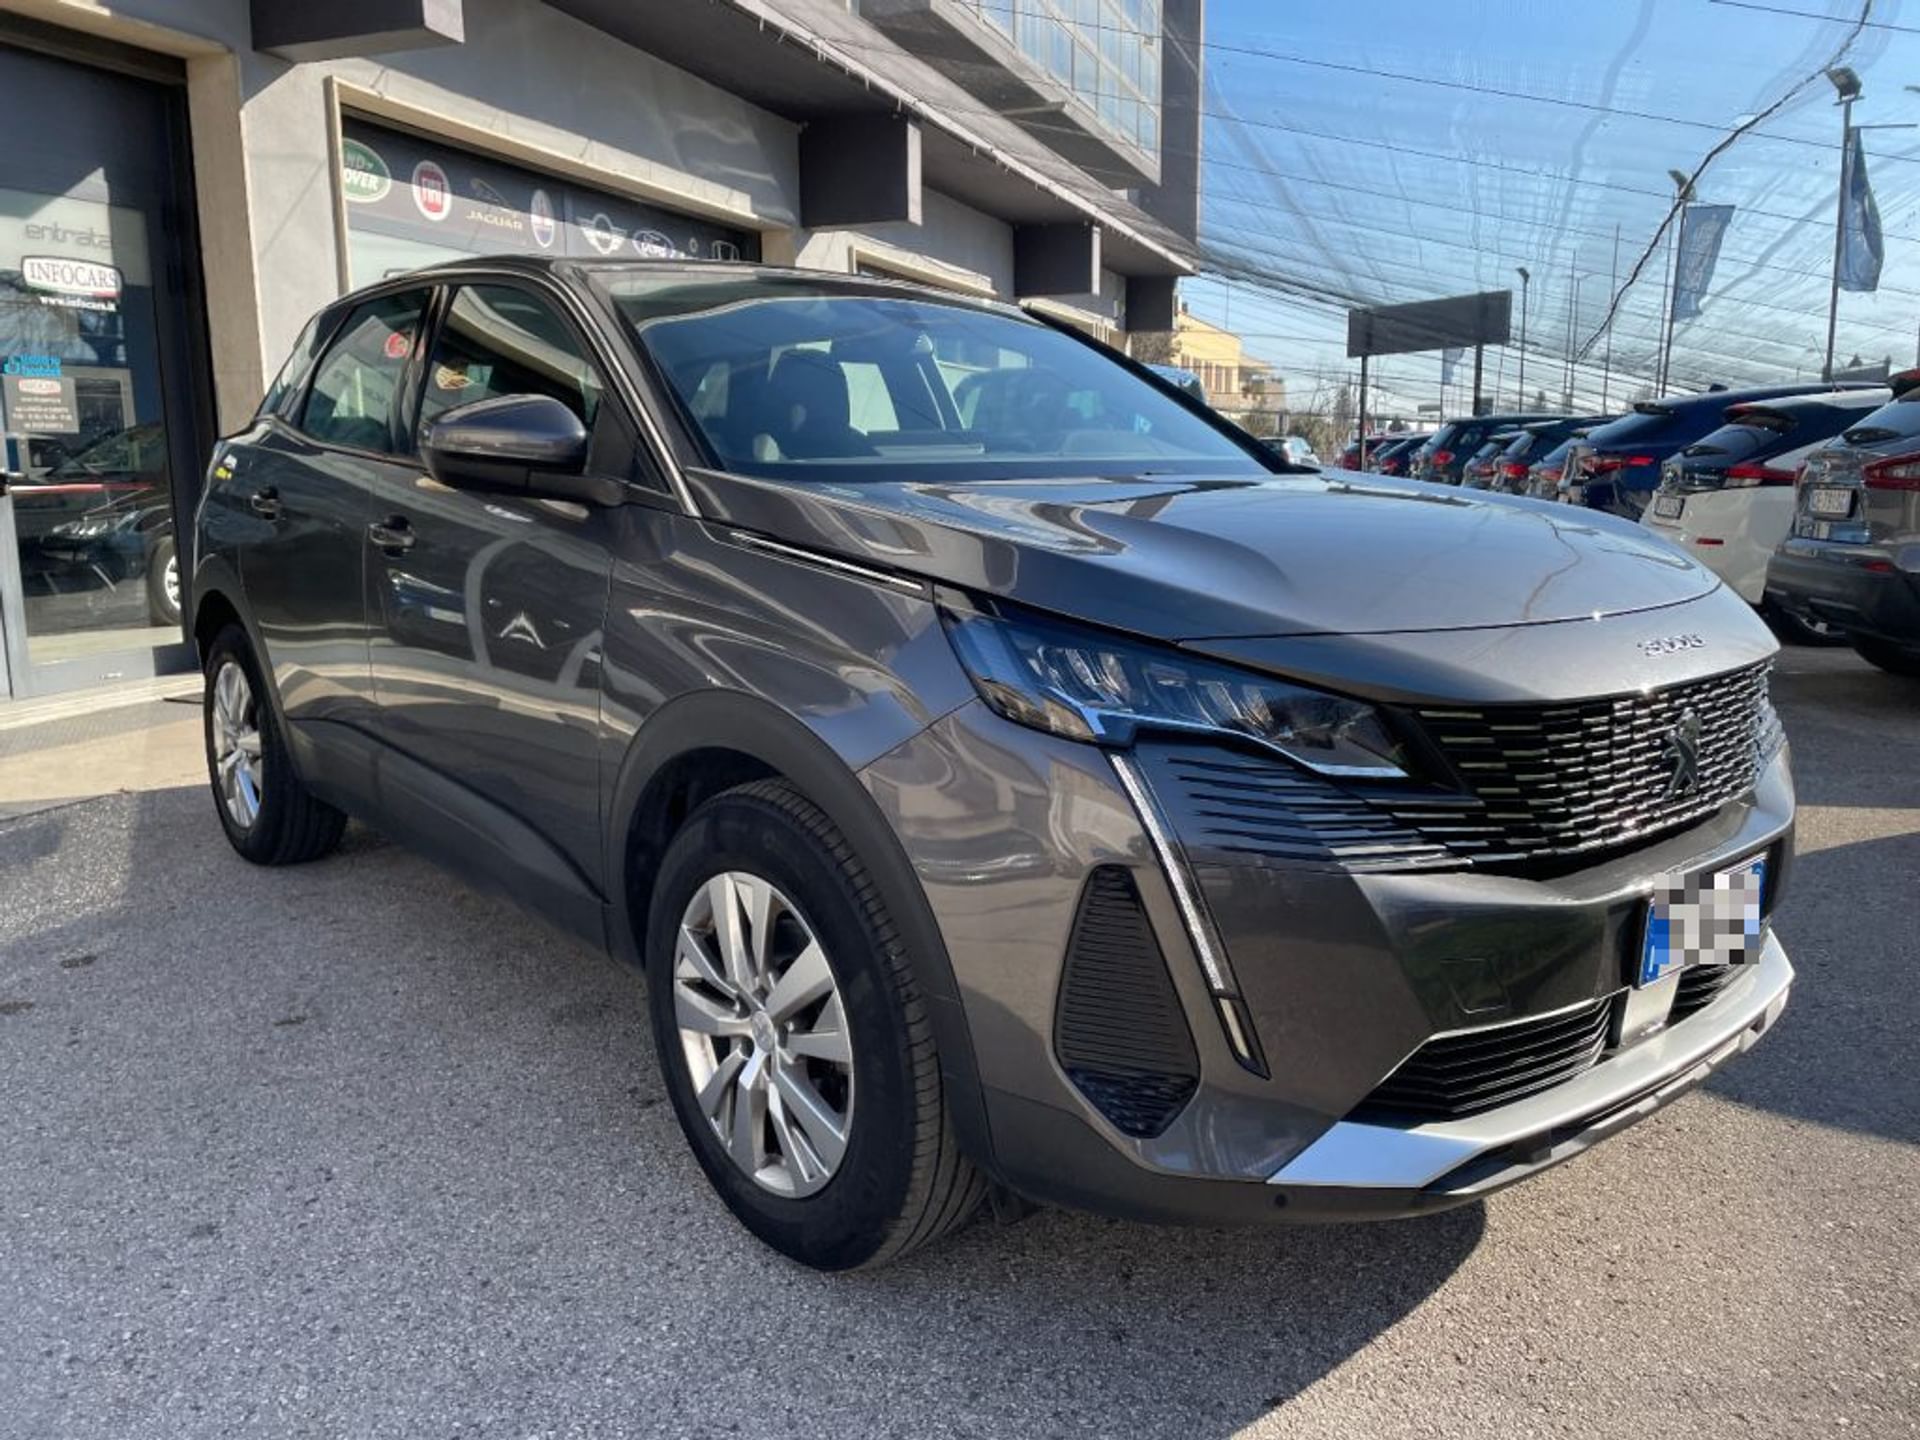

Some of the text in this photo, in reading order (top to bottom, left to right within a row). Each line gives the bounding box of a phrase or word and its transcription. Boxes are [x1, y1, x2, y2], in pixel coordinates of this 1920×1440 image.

[343, 168, 378, 192] OVER
[465, 210, 523, 232] JAGUAR
[26, 222, 113, 250] entrata
[29, 262, 118, 289] INFOCARS
